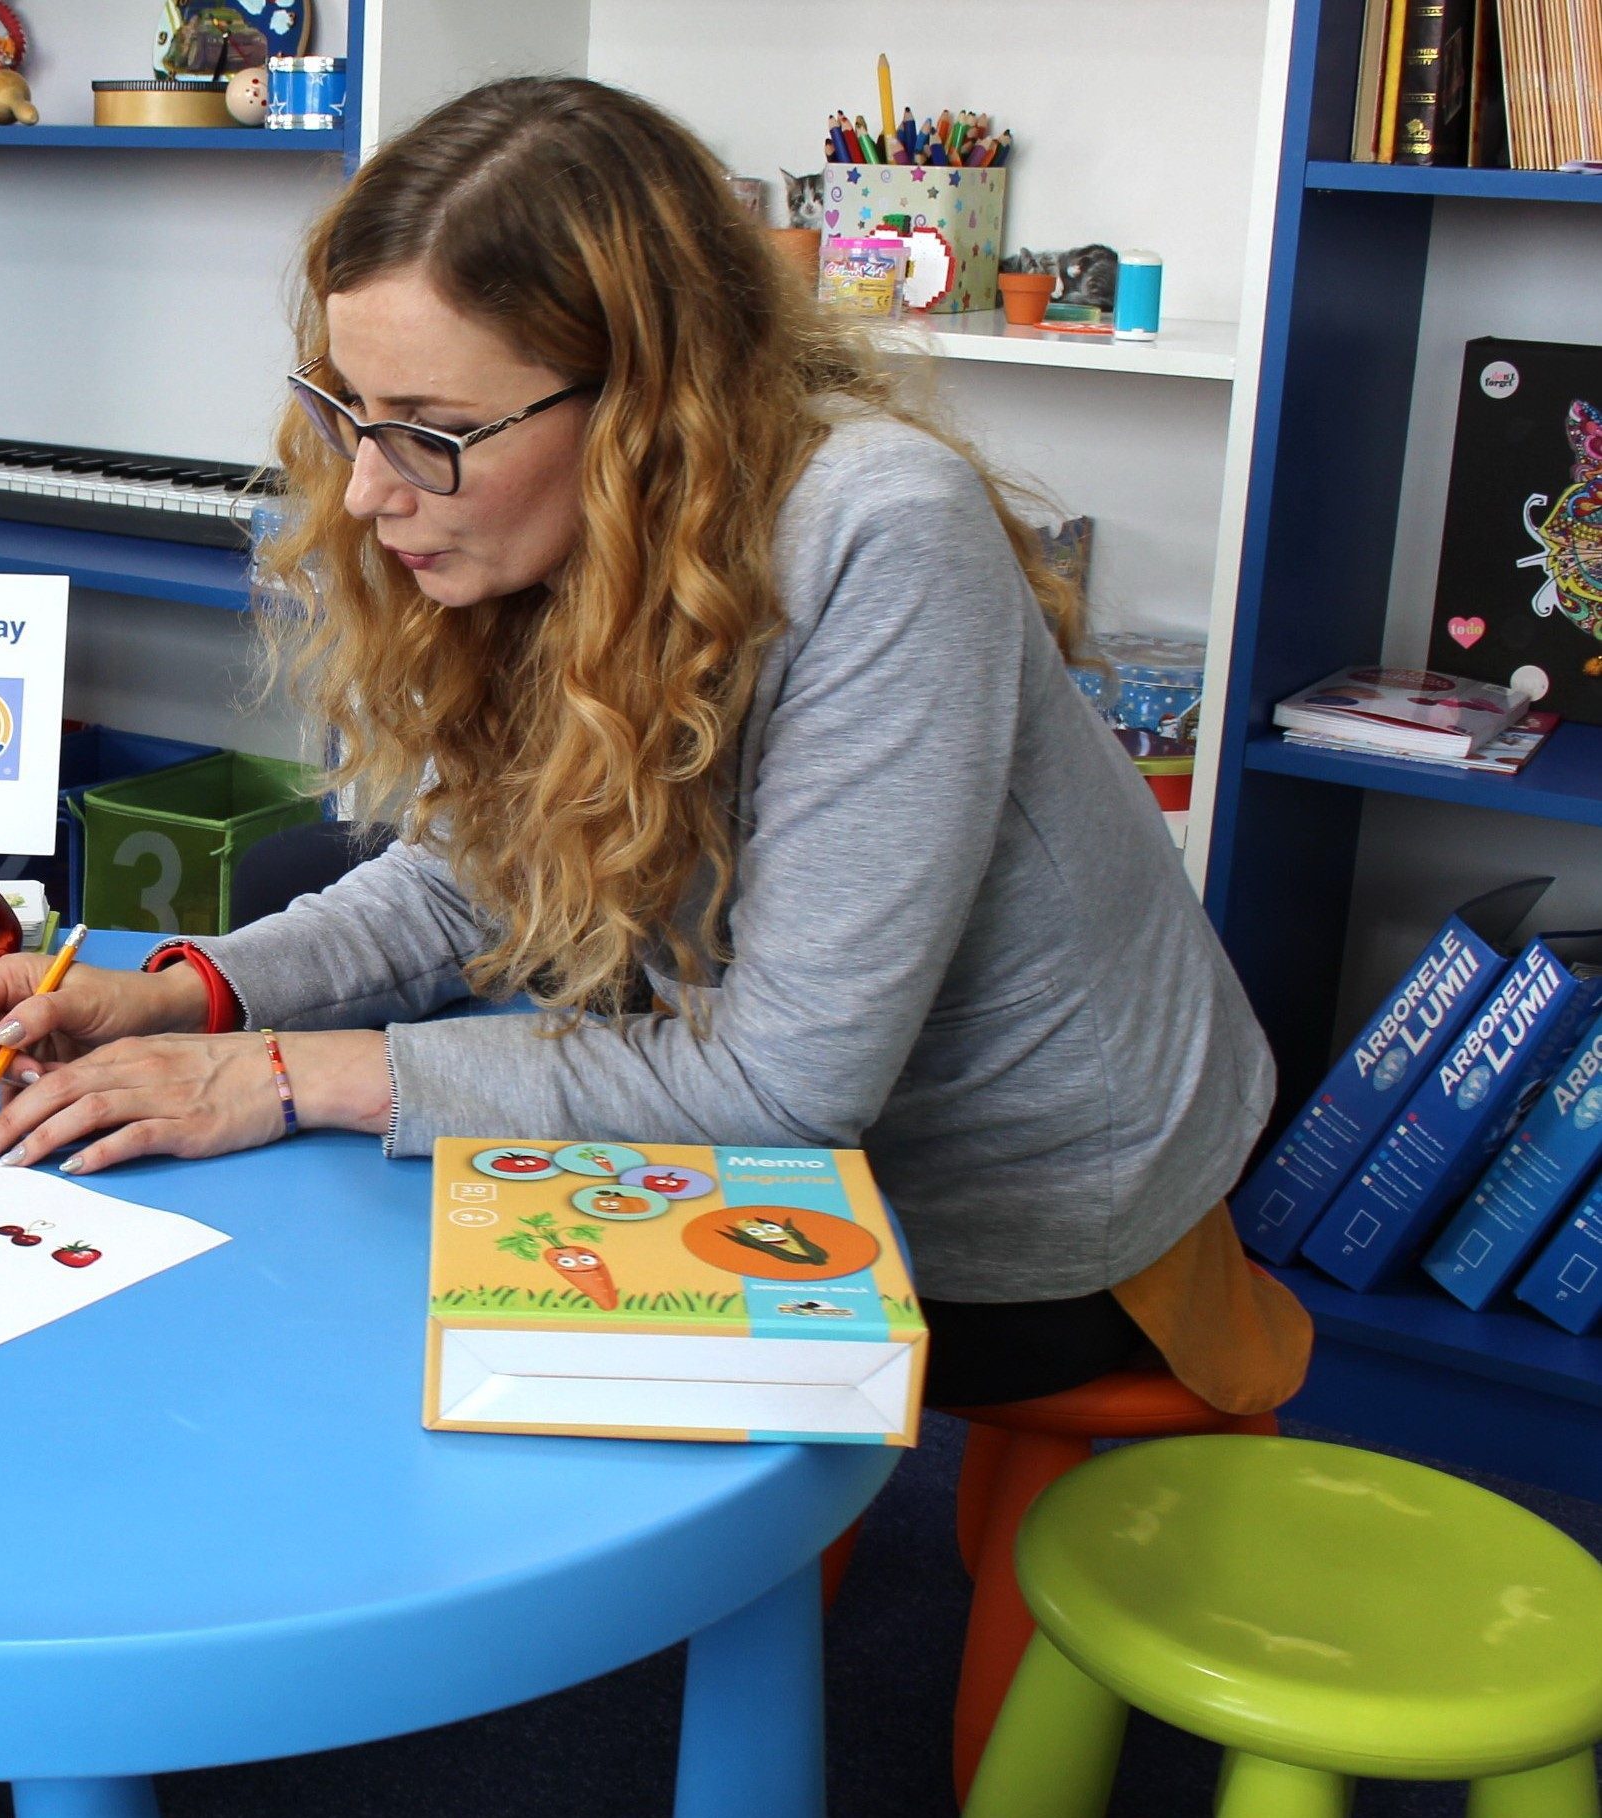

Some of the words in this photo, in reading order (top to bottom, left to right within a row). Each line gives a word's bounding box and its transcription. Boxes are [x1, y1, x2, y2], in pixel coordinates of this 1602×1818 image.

[110, 830, 183, 935] 3
[1353, 929, 1462, 1079] ARBORELE
[1398, 946, 1480, 1057] LUMII
[1438, 944, 1546, 1097] ARBORELE
[1483, 961, 1561, 1075] LUMII
[726, 1156, 826, 1169] Memo
